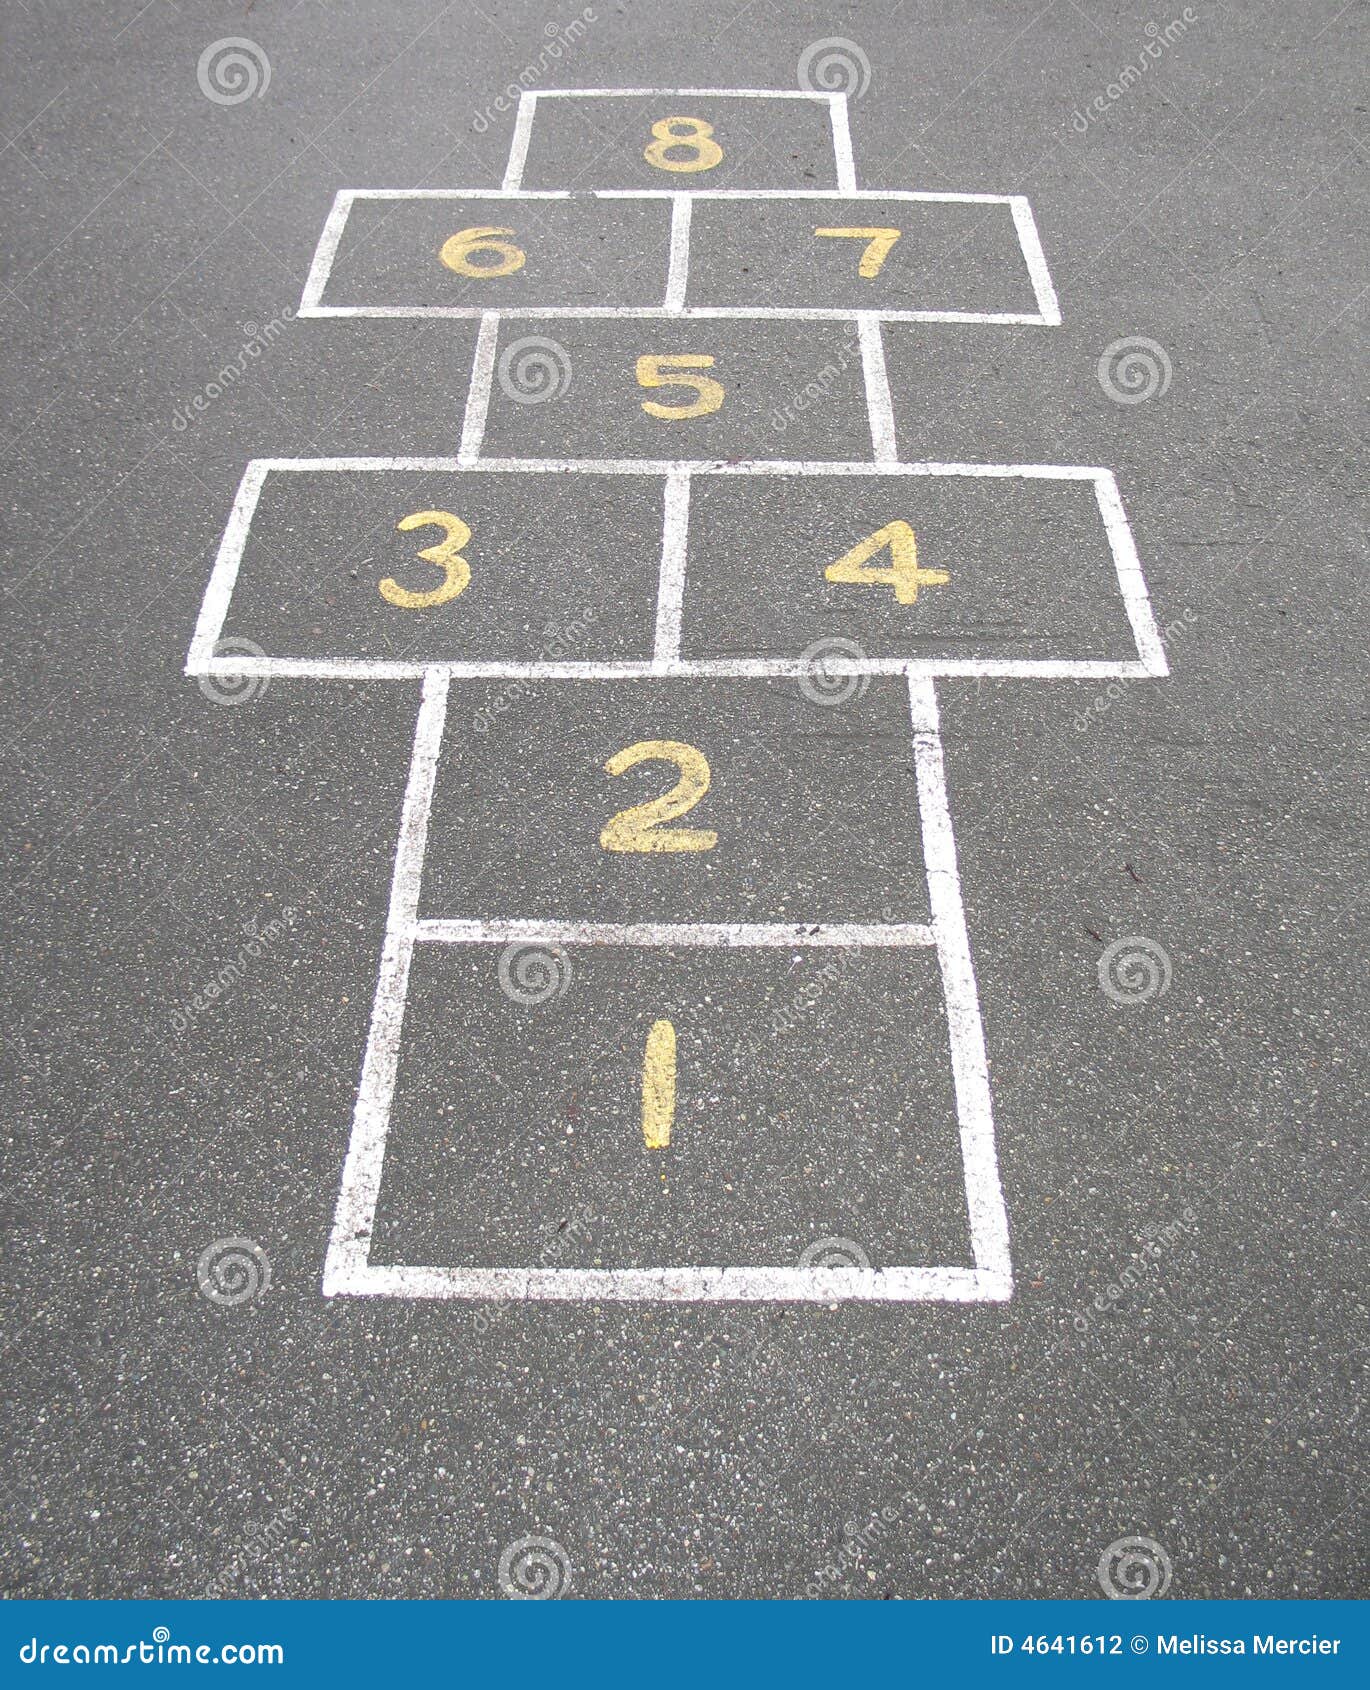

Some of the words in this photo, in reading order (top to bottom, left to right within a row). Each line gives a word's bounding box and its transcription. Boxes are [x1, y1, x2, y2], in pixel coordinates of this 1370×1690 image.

[643, 116, 724, 173] 8
[438, 227, 526, 279] 6
[814, 226, 901, 279] 7
[635, 354, 725, 420] 5
[379, 510, 473, 610] 3
[824, 520, 949, 606] 4
[600, 740, 719, 853] 2
